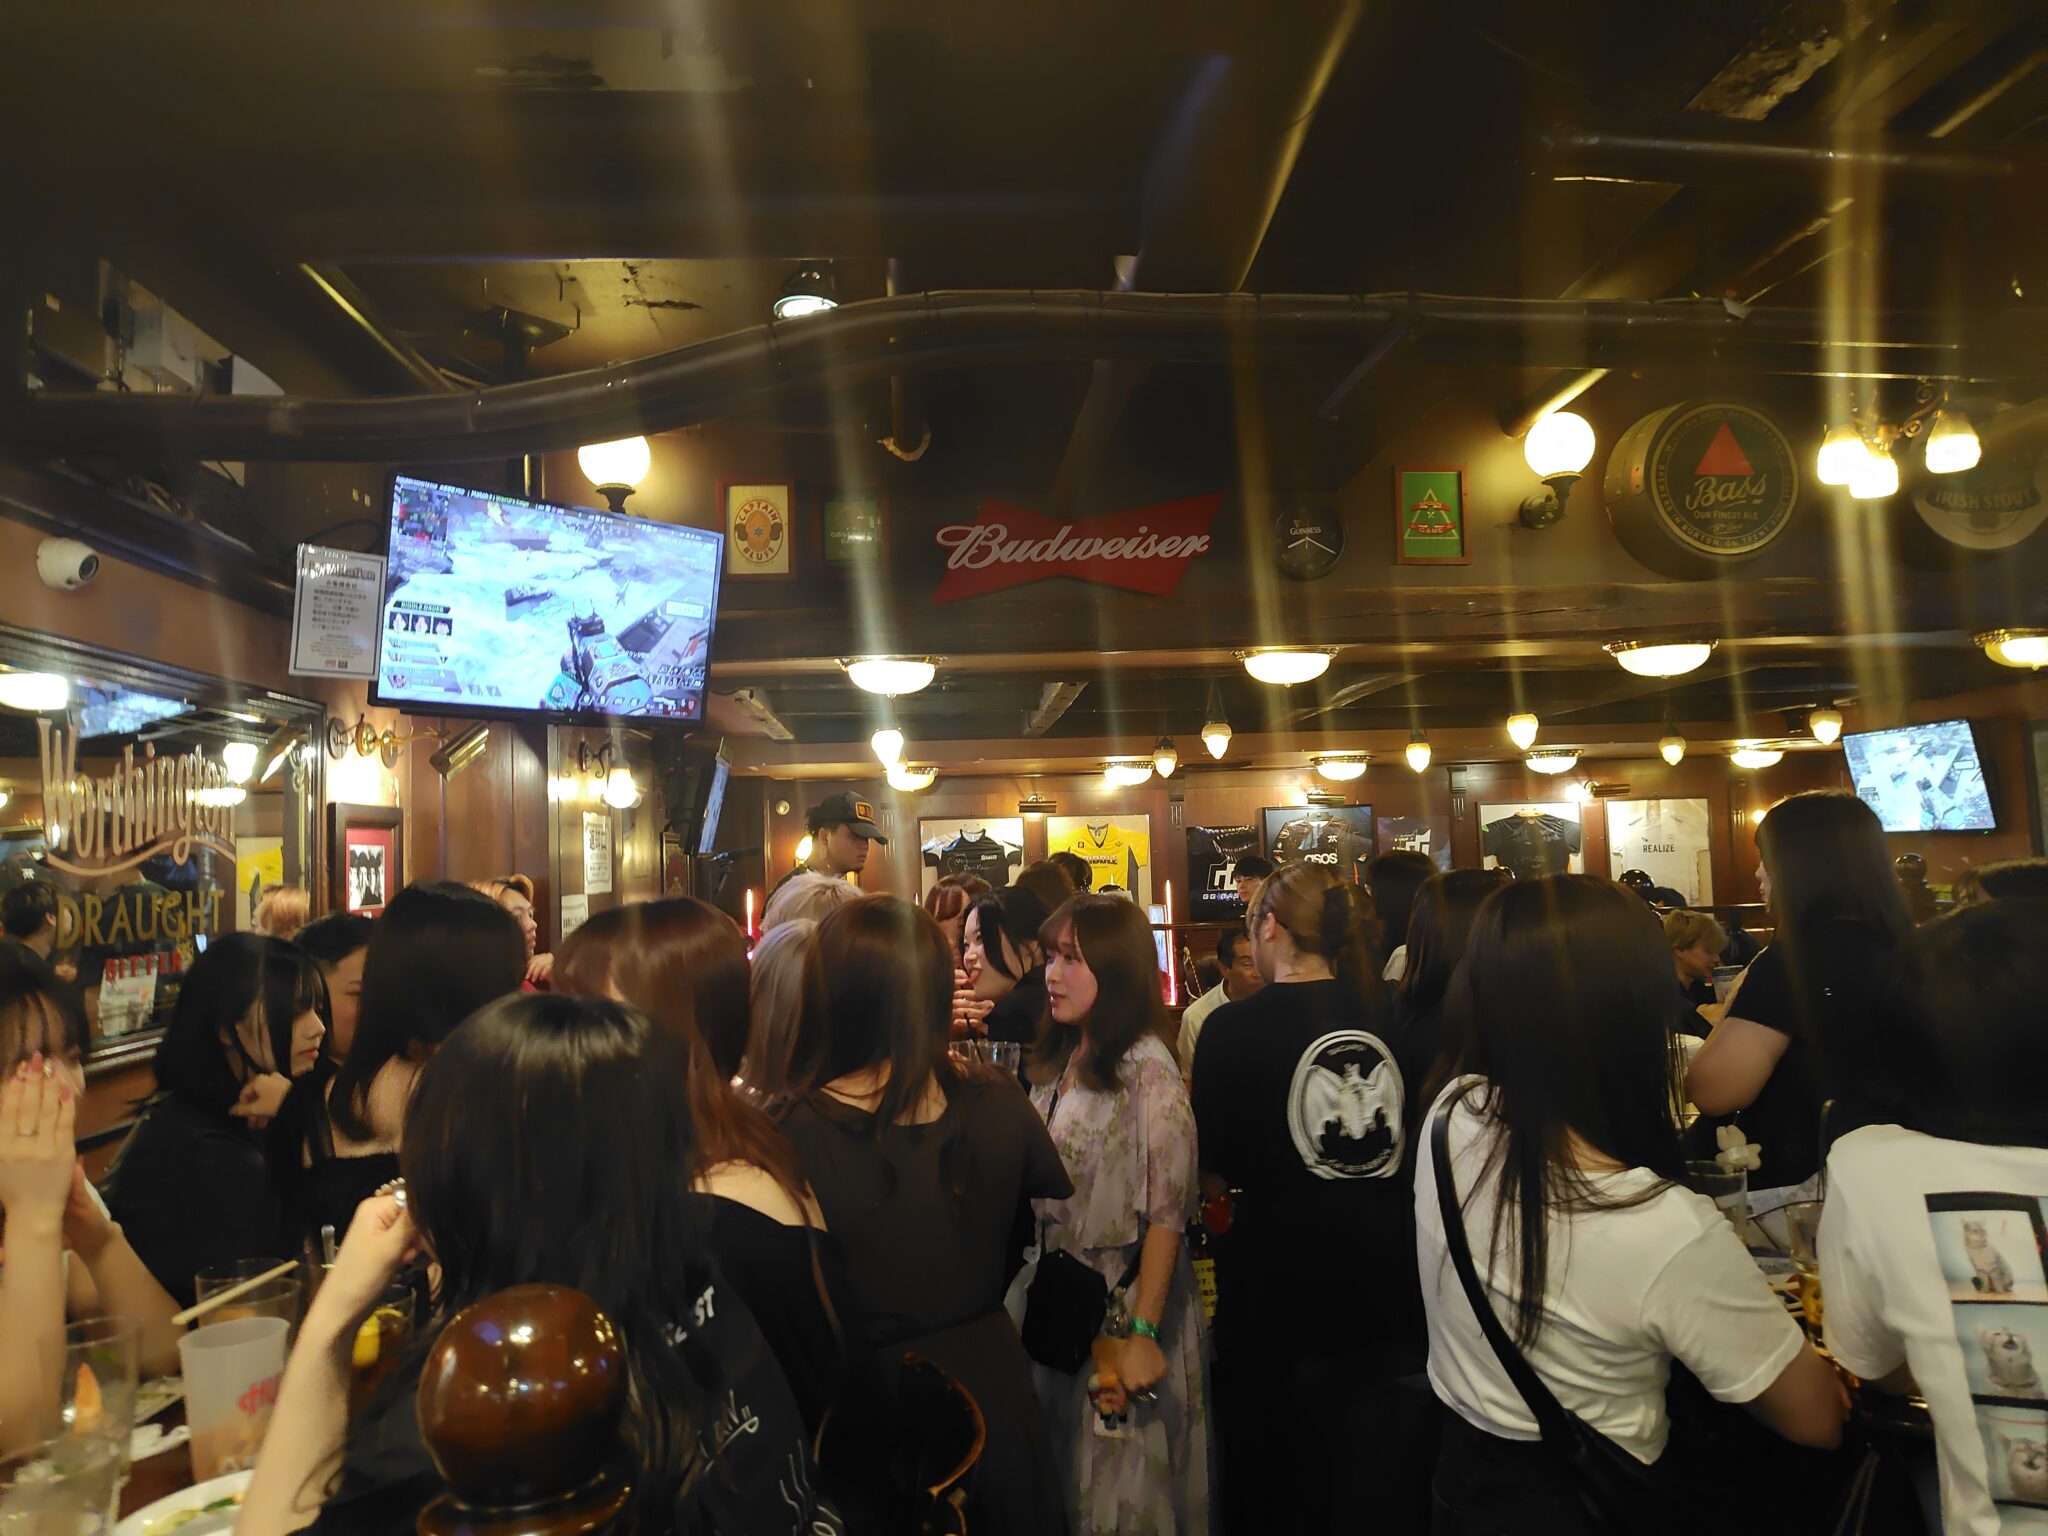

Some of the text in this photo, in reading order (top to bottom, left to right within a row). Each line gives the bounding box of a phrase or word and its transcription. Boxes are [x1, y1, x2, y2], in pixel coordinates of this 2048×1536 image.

[1685, 473, 1767, 510] Bass
[1935, 488, 2032, 509] IRISH STOUT
[738, 501, 779, 521] CAPTAIN
[1289, 527, 1322, 535] GUINNESS
[742, 546, 774, 561] BLUFF
[936, 524, 1210, 569] Budweiser
[36, 718, 236, 866] Worthington
[1304, 852, 1338, 865] asos
[1642, 844, 1675, 853] REALIZE
[56, 889, 225, 949] DRAUGHT
